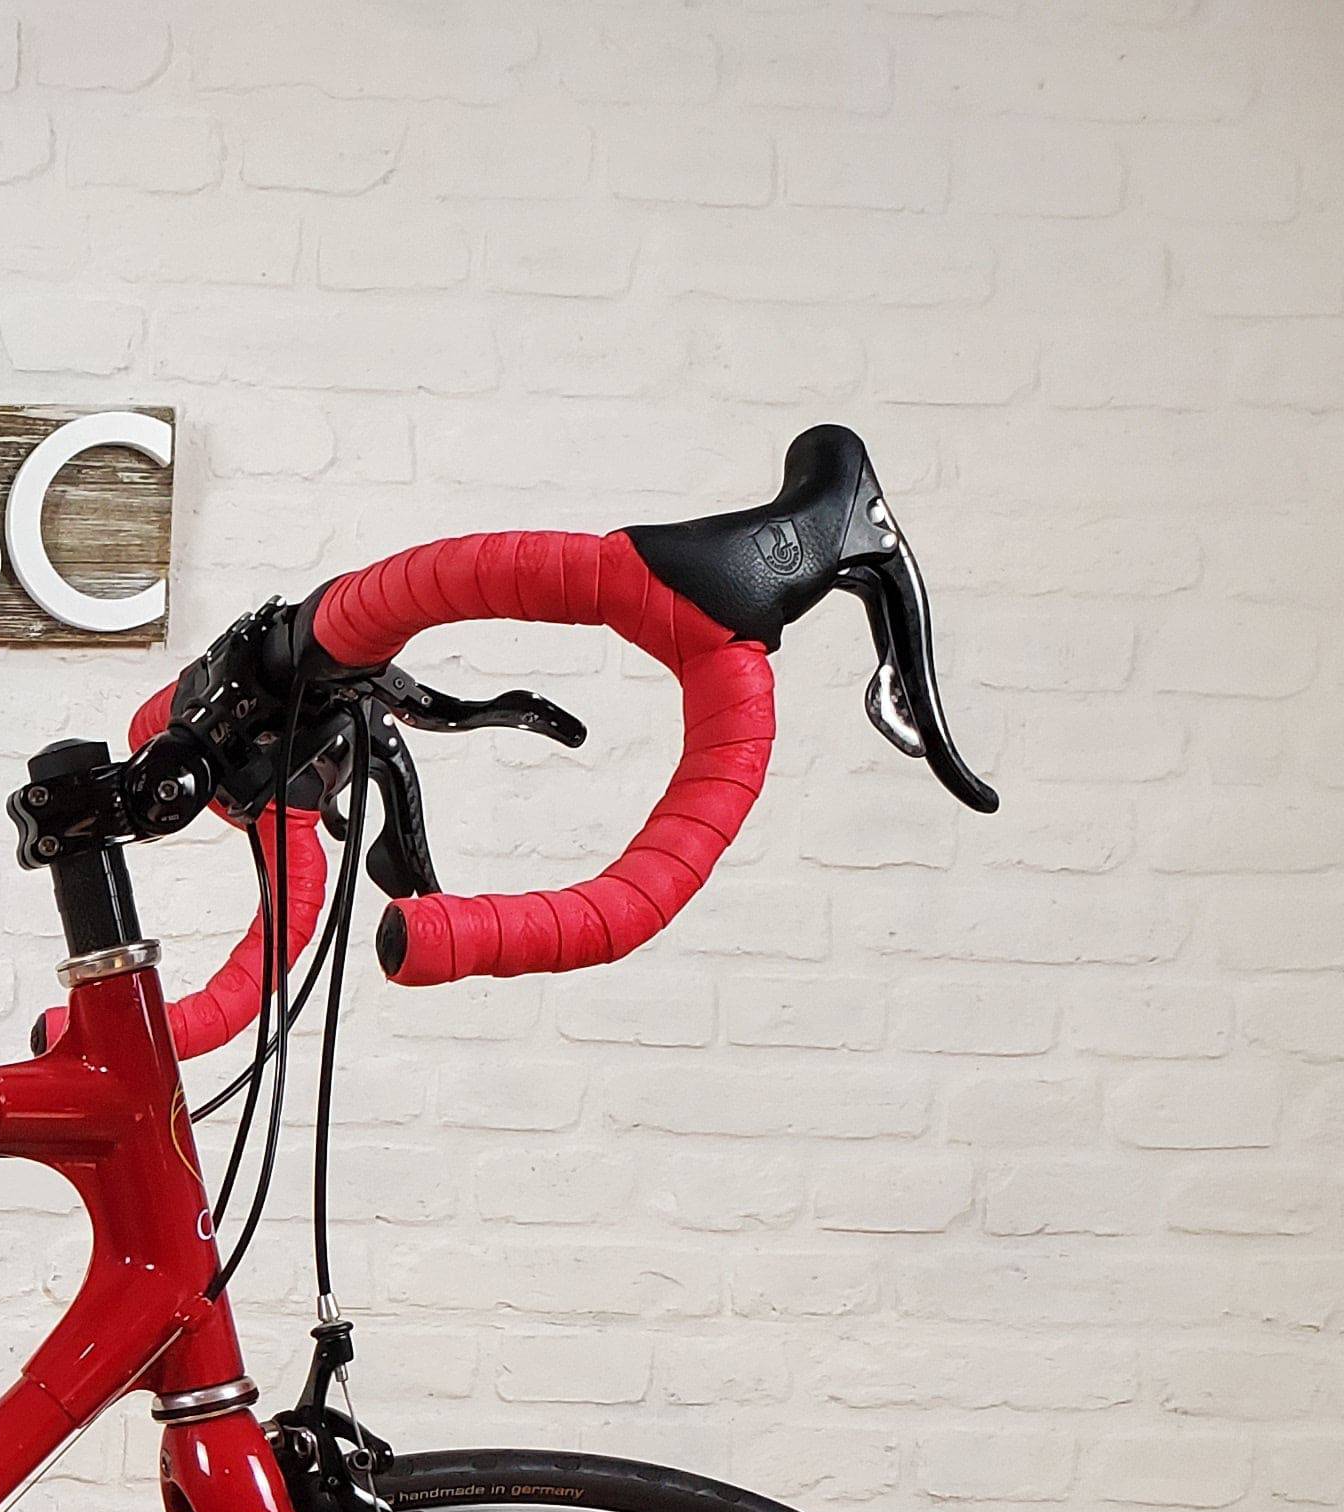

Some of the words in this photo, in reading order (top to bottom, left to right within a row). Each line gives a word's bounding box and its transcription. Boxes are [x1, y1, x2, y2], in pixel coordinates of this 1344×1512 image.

[399, 1484, 485, 1503] handmade
[491, 1484, 506, 1495] in
[511, 1484, 585, 1499] germany
